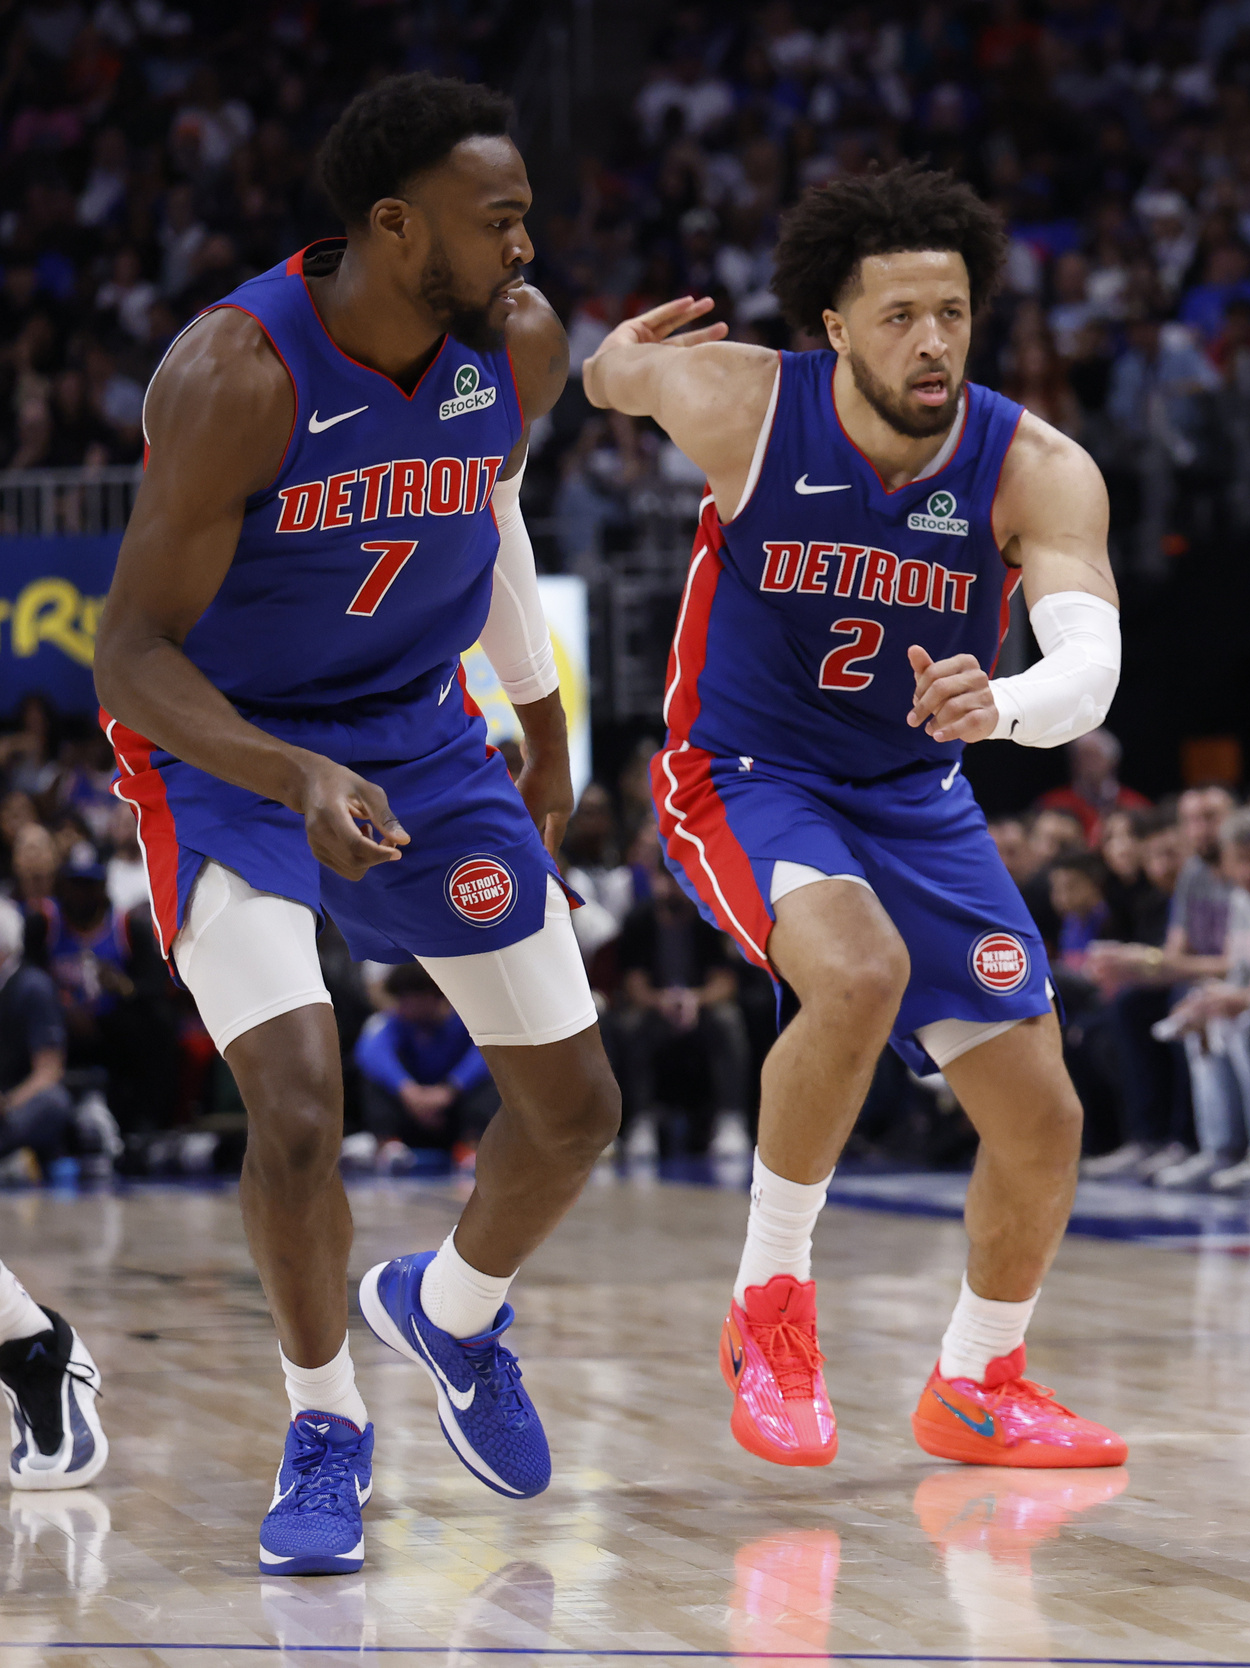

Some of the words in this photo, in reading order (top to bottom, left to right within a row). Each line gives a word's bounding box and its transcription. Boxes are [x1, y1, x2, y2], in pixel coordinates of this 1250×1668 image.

[441, 388, 494, 417] StockX
[276, 456, 504, 533] DETROIT
[910, 515, 968, 534] StockX
[345, 540, 419, 617] 7
[759, 540, 977, 614] DETROIT
[818, 617, 885, 691] 2
[457, 872, 501, 896] DETROIT
[460, 884, 505, 907] PISTONS
